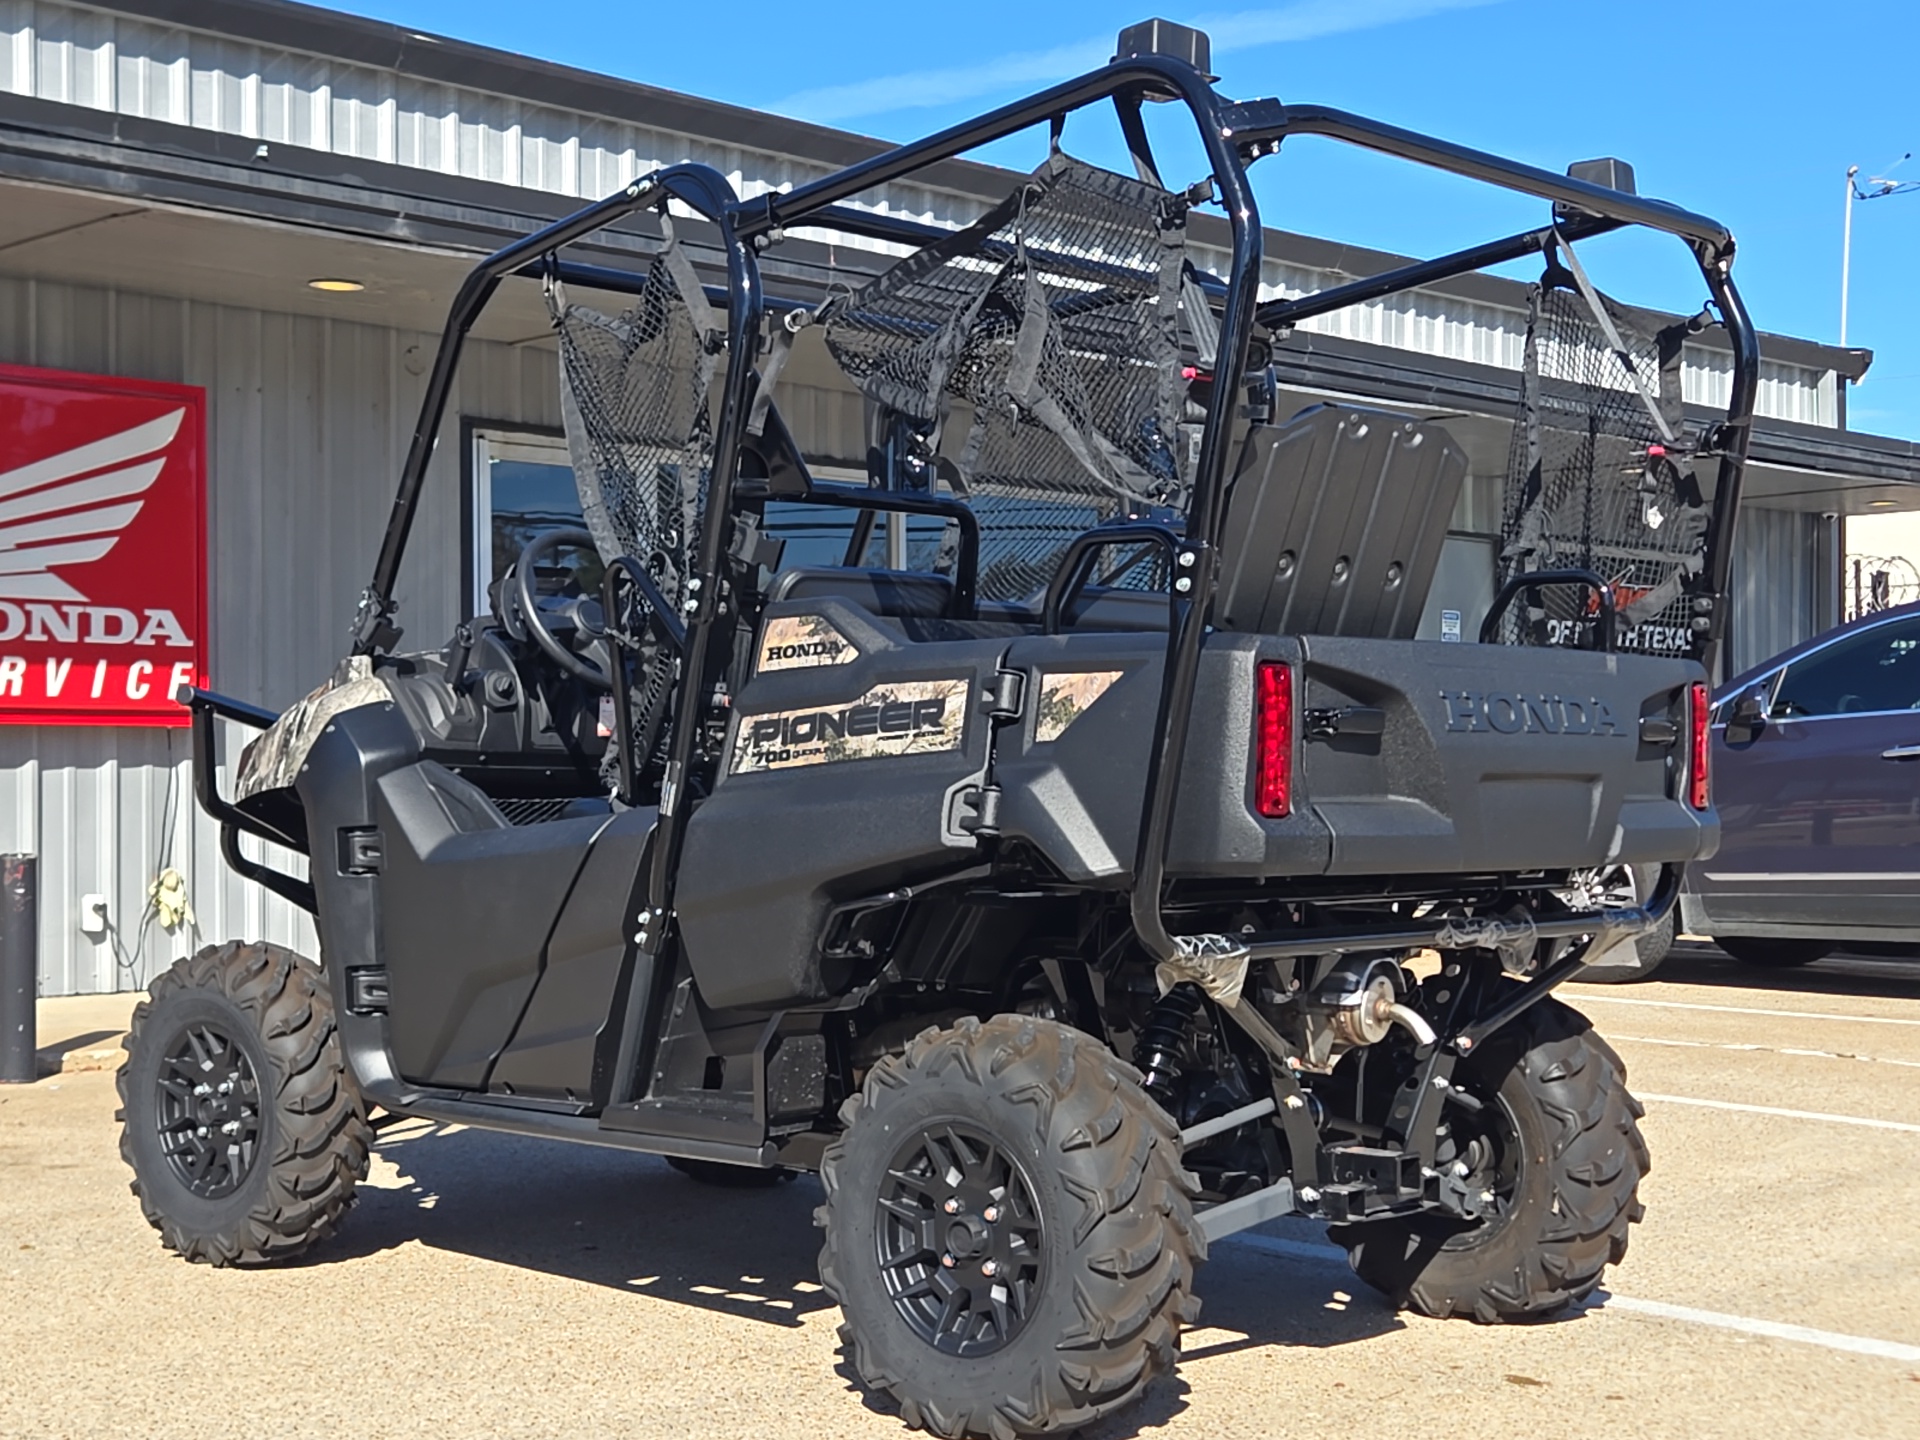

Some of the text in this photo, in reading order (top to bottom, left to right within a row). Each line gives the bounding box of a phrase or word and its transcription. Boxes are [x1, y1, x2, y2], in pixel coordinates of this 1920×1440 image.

[766, 640, 843, 662] HONDA
[753, 698, 946, 748] PIONEER
[1439, 690, 1628, 737] HONDA
[752, 749, 791, 765] 700
